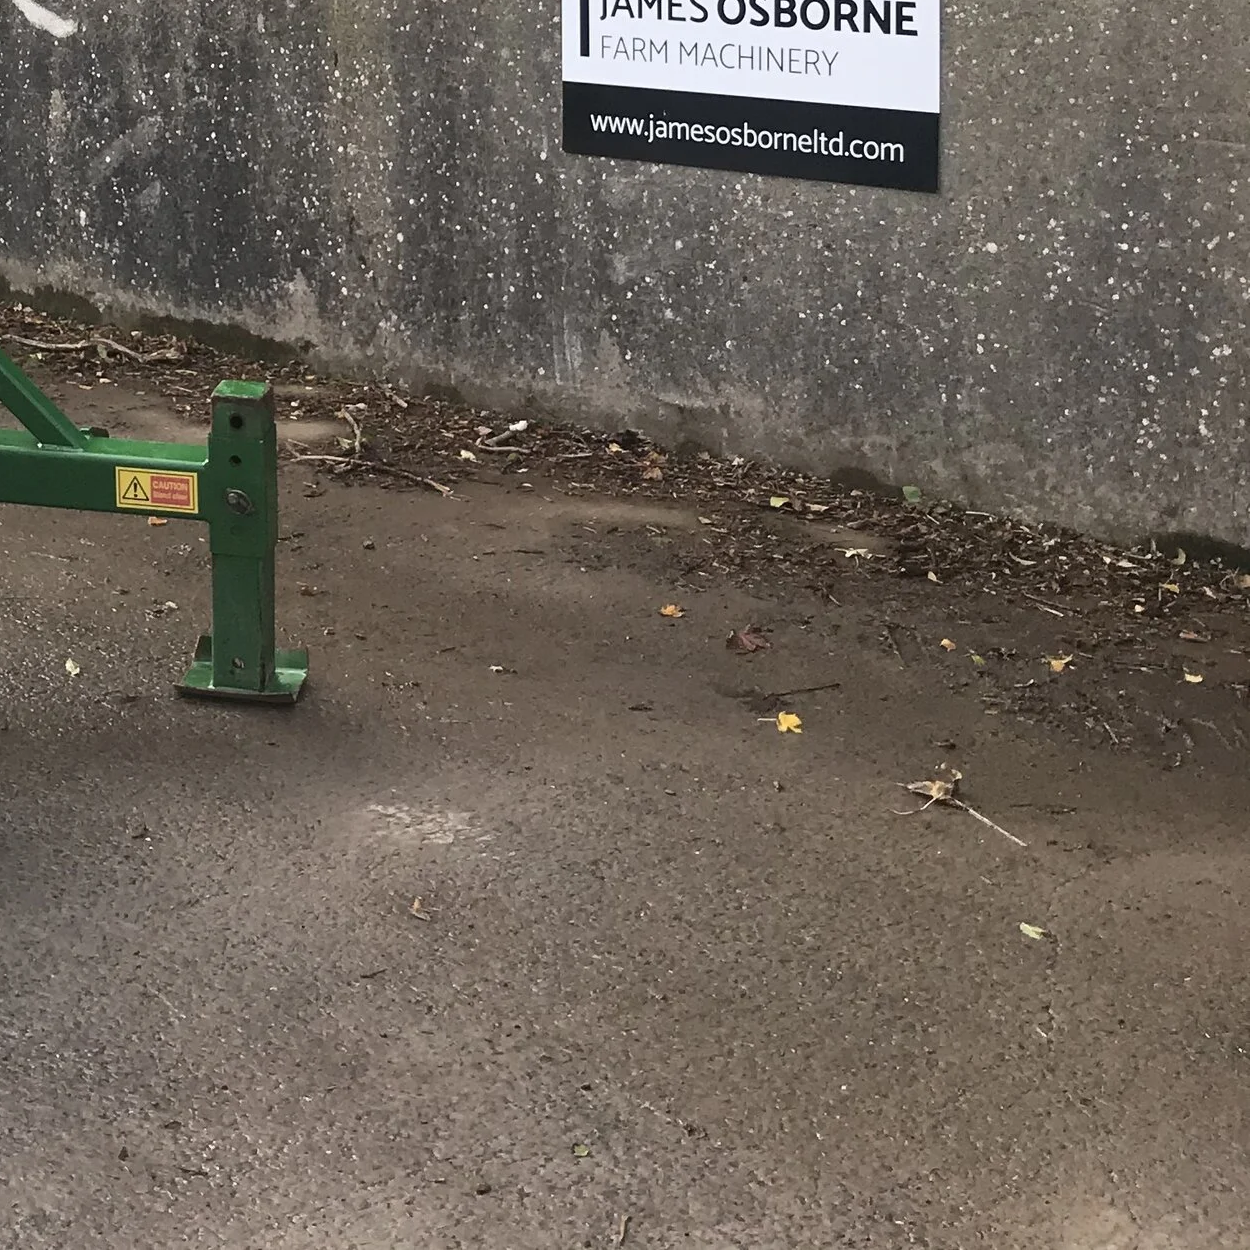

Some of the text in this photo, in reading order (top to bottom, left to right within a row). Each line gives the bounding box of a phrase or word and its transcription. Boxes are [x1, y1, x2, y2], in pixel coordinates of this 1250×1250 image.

[601, 35, 839, 76] FARM MACHINERY
[589, 113, 905, 163] www.jamesosborneltd.com
[152, 480, 188, 491] CAUTION
